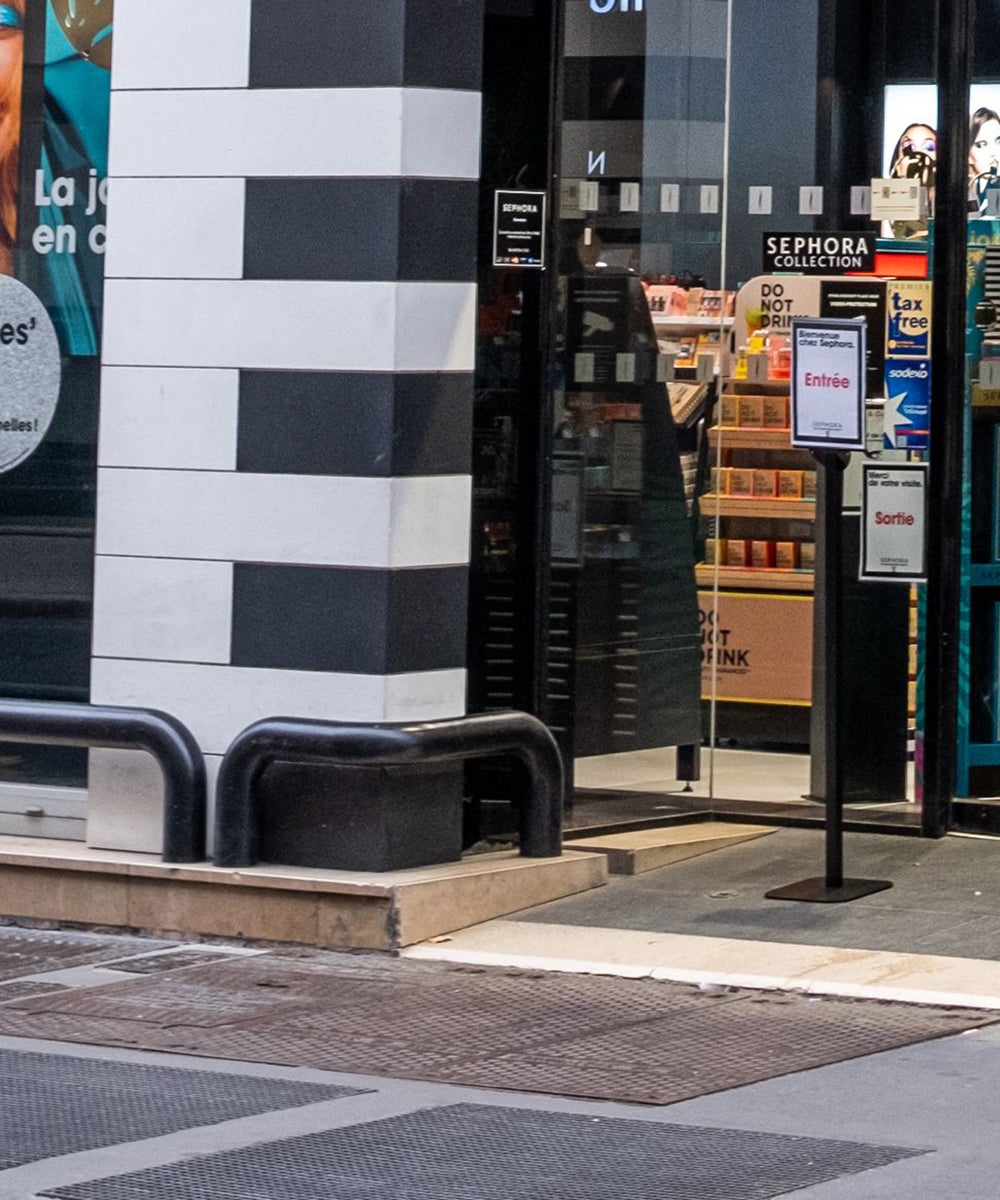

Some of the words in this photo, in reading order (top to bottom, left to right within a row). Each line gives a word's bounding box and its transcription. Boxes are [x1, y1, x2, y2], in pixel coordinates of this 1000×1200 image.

[34, 169, 75, 207] La
[502, 203, 538, 213] SEPHORA
[32, 224, 76, 255] en
[766, 237, 869, 255] SEPHORA
[774, 255, 863, 268] COLLECTION
[761, 284, 784, 298] DO
[761, 299, 794, 313] NOT
[892, 292, 923, 311] tax
[893, 311, 929, 333] free
[799, 329, 840, 339] Bienvenue
[799, 339, 818, 347] chez
[820, 339, 855, 349] Sephora.
[804, 372, 850, 389] Entrée
[868, 471, 889, 480] Merci
[874, 511, 915, 526] Sortie
